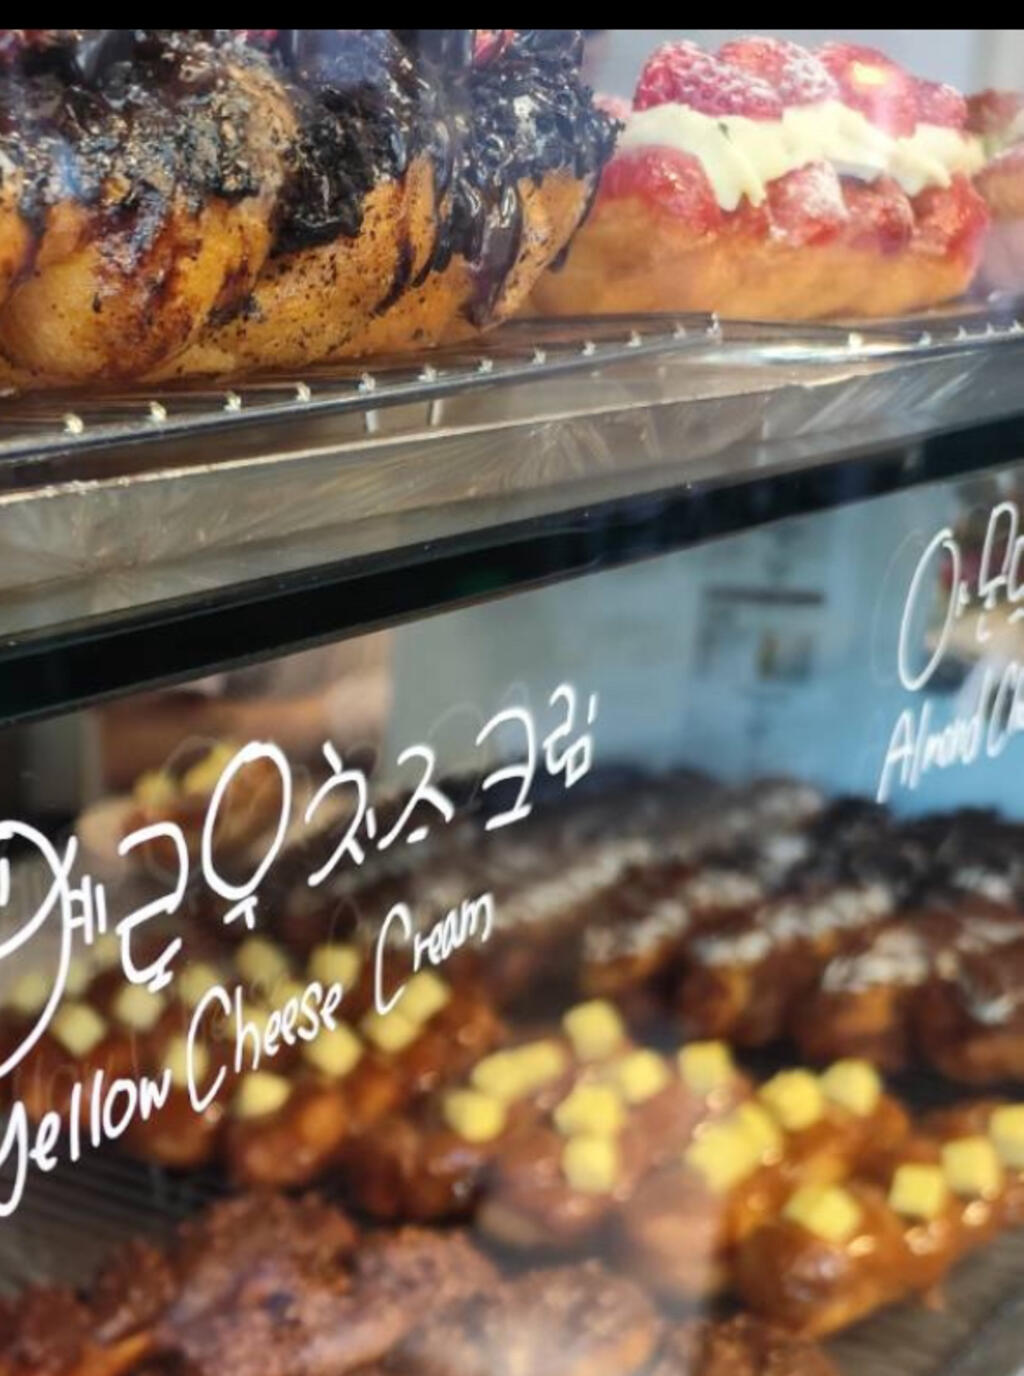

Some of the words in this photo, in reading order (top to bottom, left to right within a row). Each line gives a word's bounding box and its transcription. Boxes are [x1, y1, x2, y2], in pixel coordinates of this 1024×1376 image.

[475, 682, 598, 832] 크림
[185, 980, 345, 1114] Cheese
[374, 891, 494, 1017] Cream
